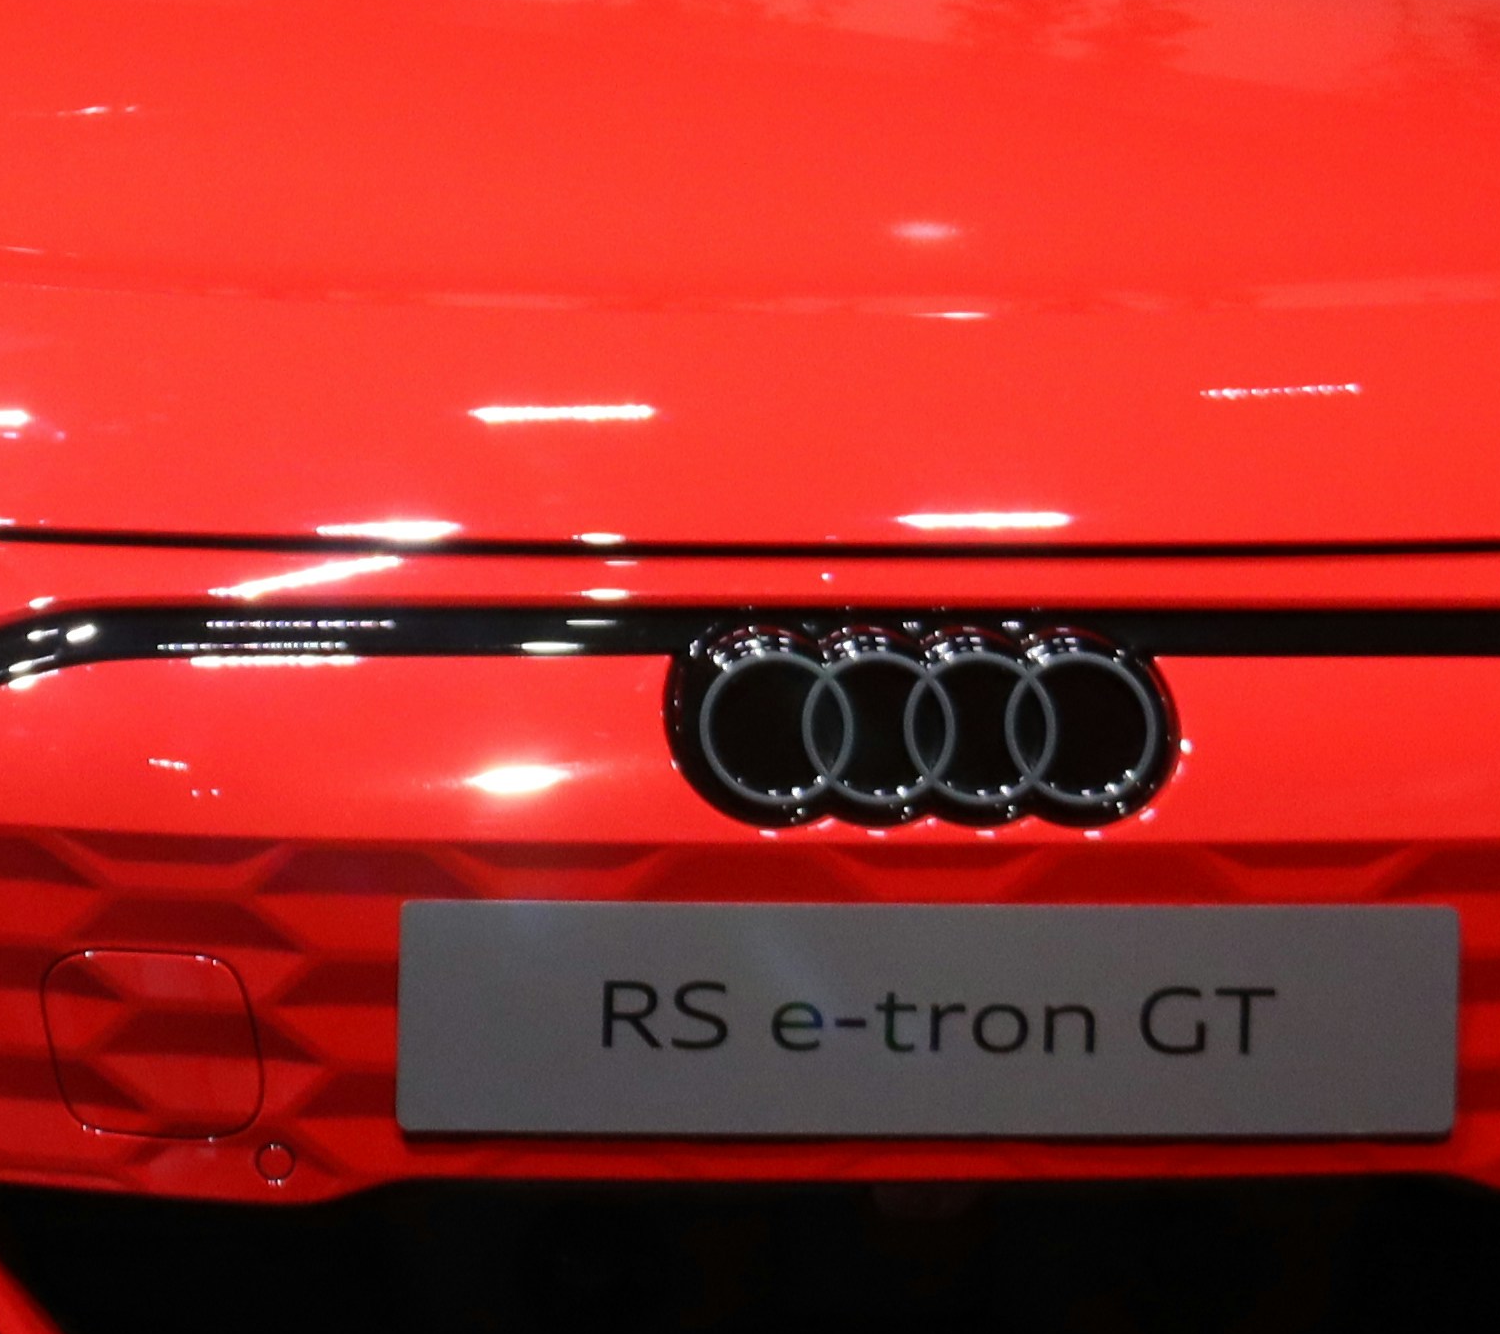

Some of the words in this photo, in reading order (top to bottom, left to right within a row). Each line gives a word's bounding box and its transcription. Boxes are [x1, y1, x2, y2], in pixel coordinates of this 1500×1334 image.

[600, 979, 730, 1053] RS
[769, 991, 1098, 1056] e-tron
[1138, 984, 1278, 1058] GT
